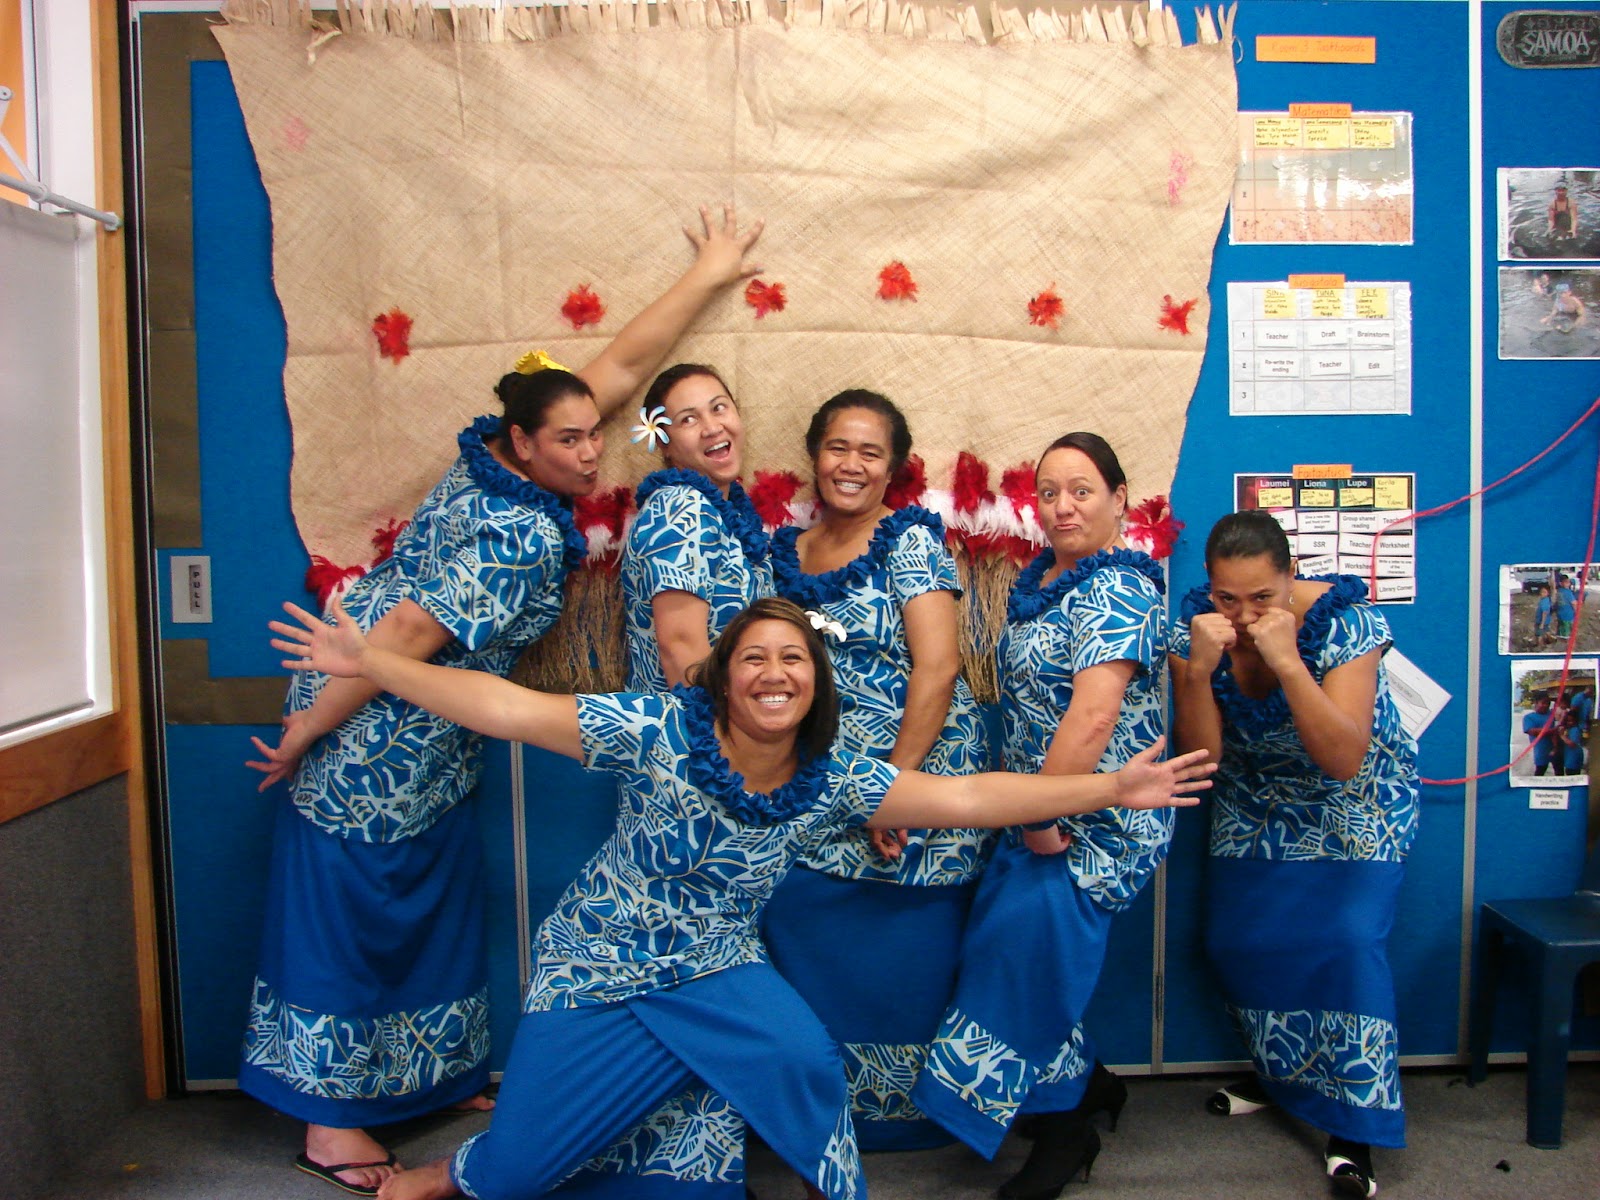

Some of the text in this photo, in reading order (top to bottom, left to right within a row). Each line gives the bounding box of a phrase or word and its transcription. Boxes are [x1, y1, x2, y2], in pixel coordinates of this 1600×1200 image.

[1521, 31, 1590, 56] SAMOA
[1259, 479, 1290, 488] Laumei
[1304, 480, 1327, 488] Liona
[1347, 479, 1367, 488] Lupe
[193, 571, 201, 608] PULL
